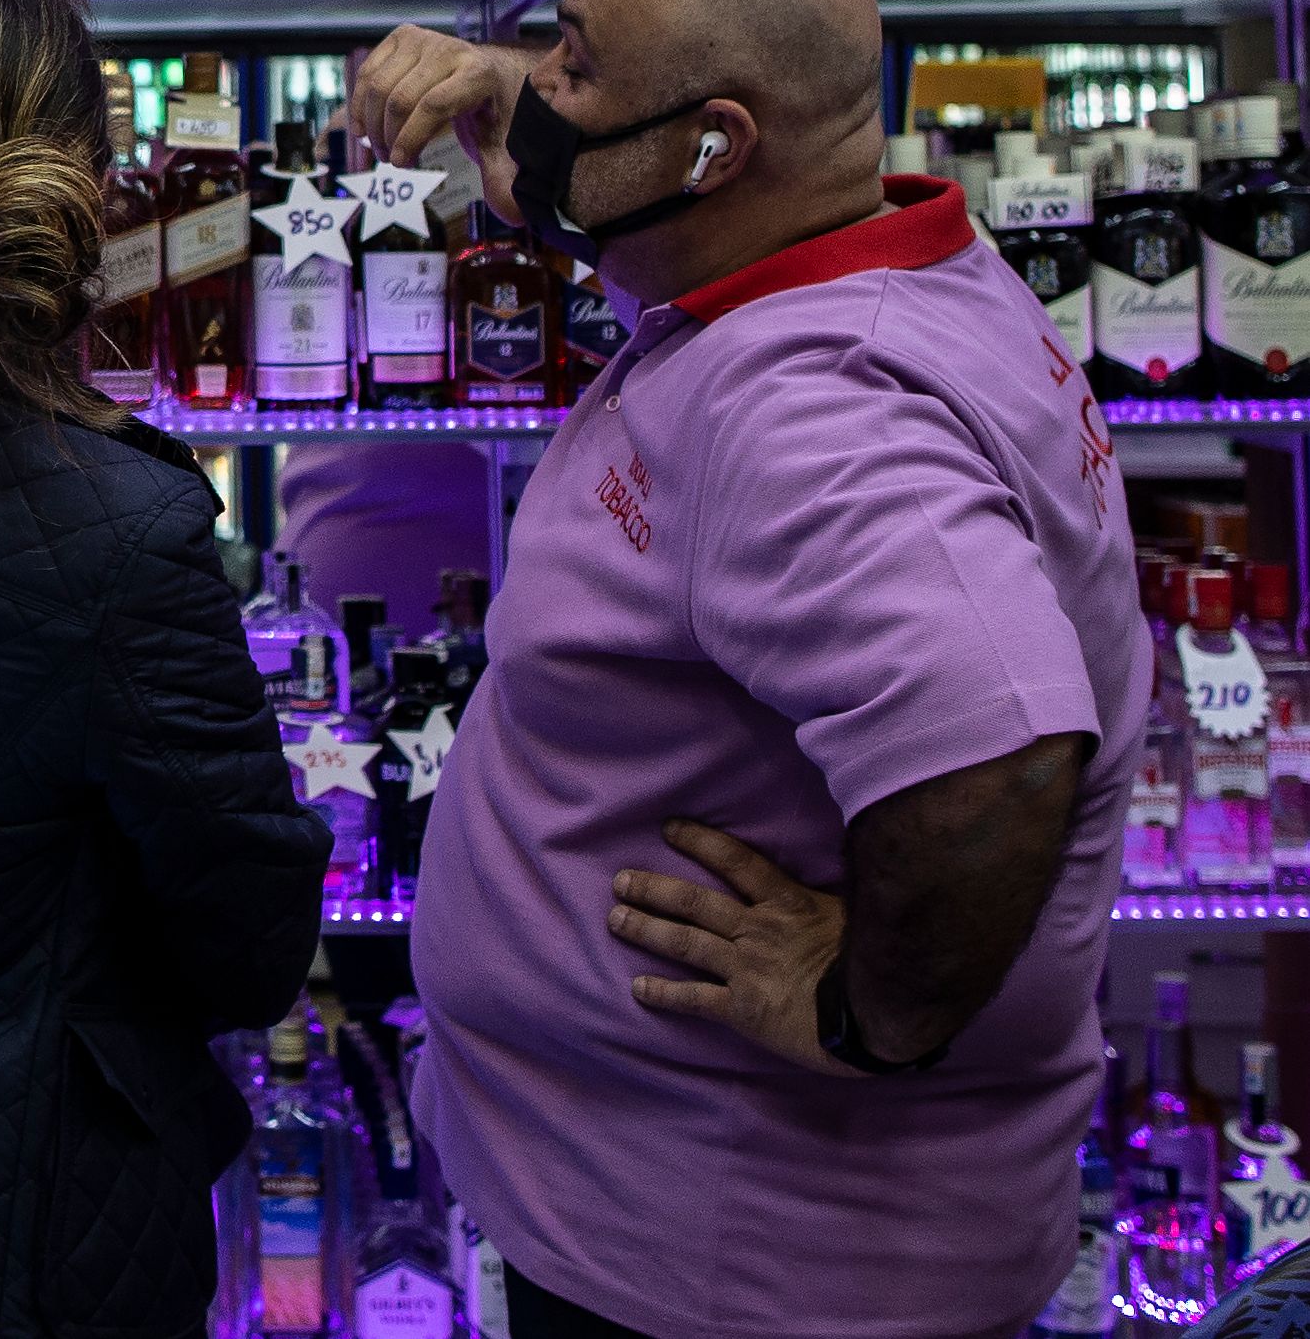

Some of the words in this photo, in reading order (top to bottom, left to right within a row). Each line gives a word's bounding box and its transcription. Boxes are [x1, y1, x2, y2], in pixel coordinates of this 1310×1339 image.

[366, 177, 414, 209] 450
[288, 208, 334, 236] 850
[414, 311, 430, 331] 17
[595, 465, 652, 554] TOBACCO
